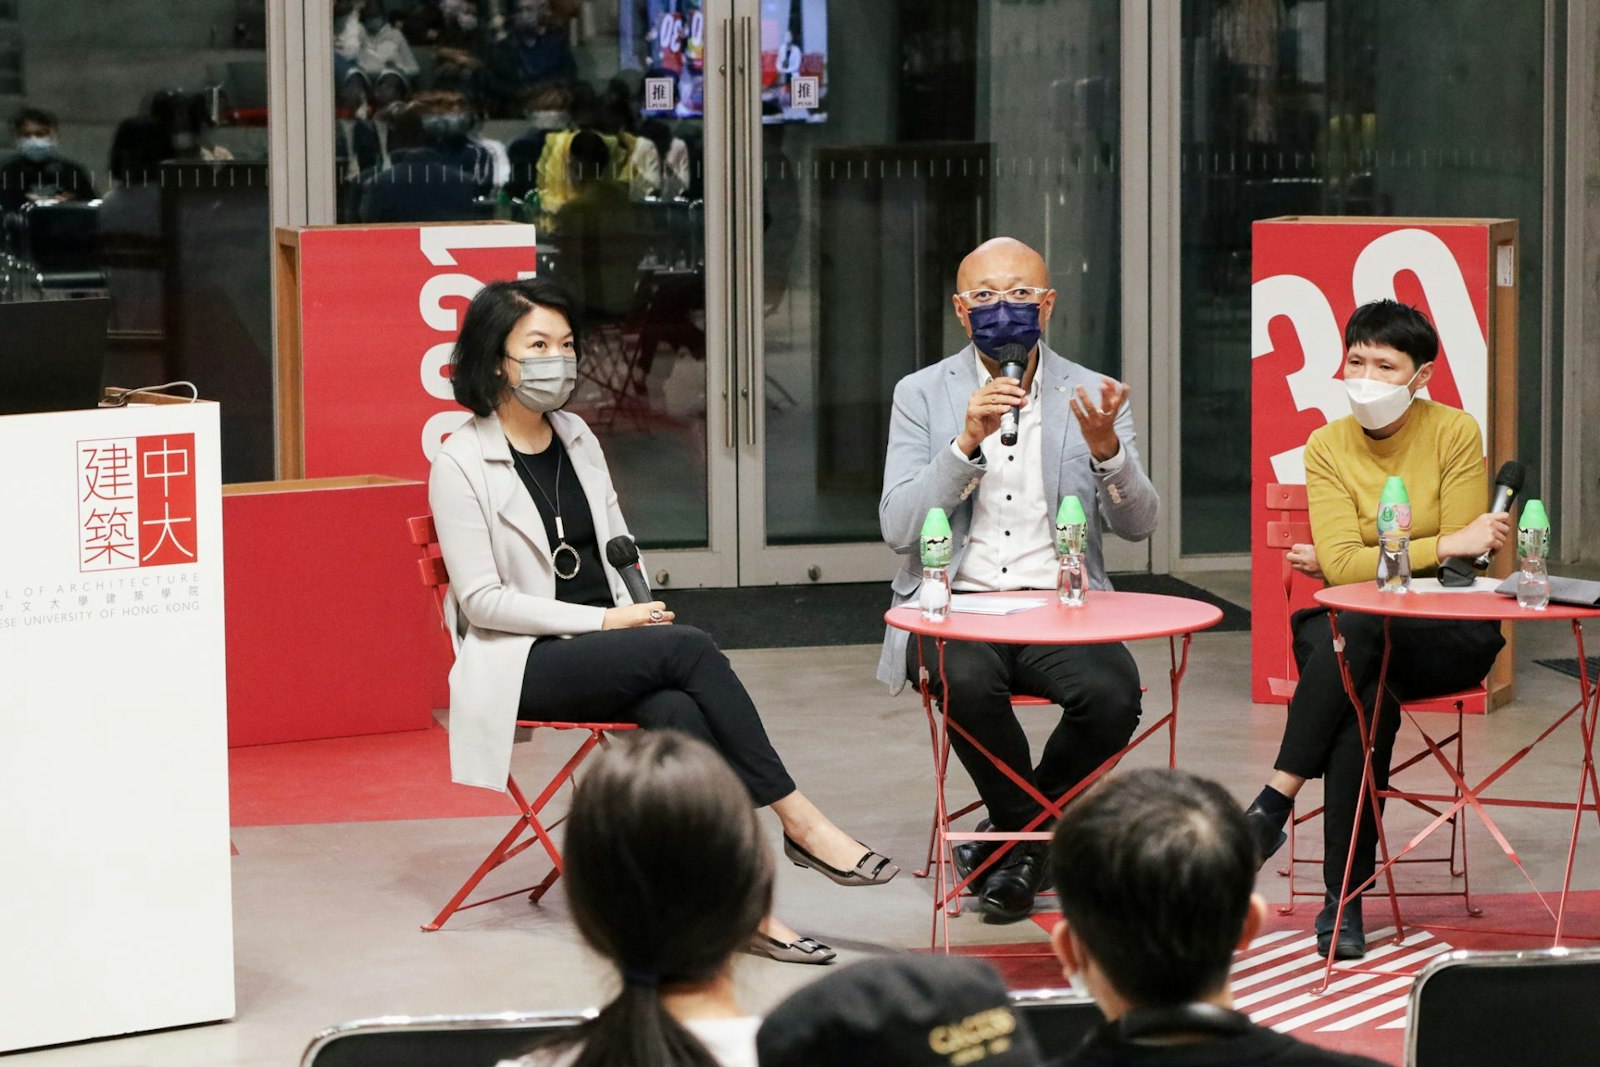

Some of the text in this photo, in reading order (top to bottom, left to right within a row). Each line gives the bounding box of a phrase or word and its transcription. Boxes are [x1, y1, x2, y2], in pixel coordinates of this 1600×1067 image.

[652, 84, 666, 100] 推
[798, 82, 811, 98] 推
[83, 443, 136, 565] 建築
[143, 439, 194, 562] 中大
[24, 586, 44, 597] OF
[56, 573, 199, 594] ARCHITECTURE
[24, 610, 93, 627] UNIVERSITY
[100, 608, 115, 620] OF
[122, 604, 159, 617] HONG
[165, 600, 200, 613] KONG
